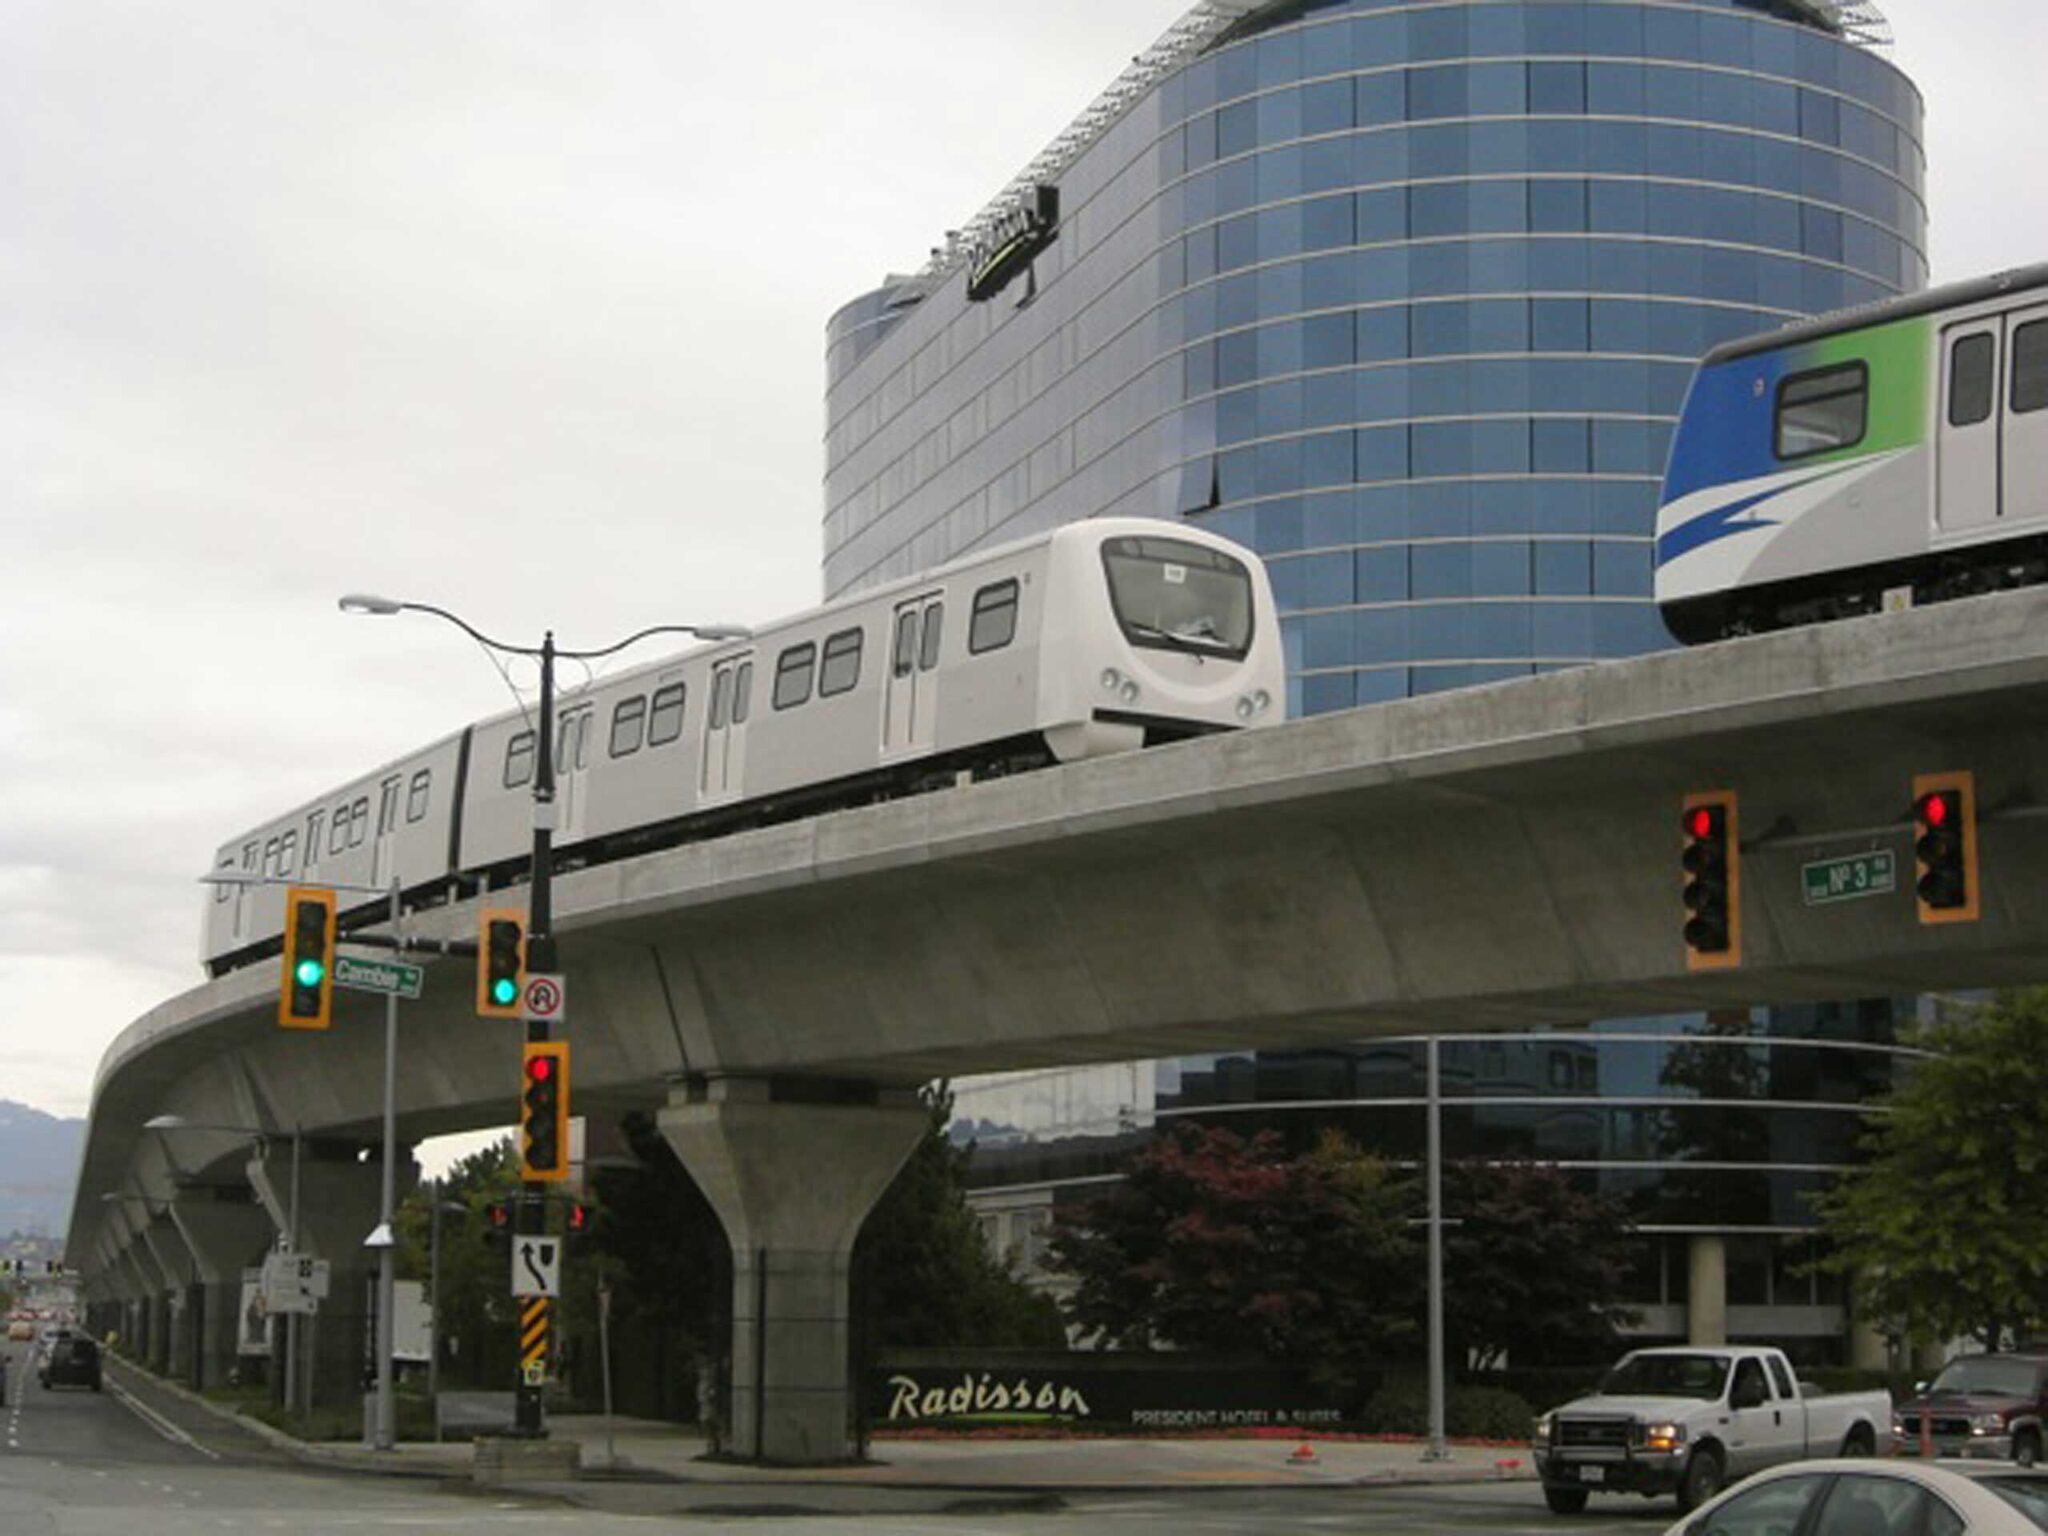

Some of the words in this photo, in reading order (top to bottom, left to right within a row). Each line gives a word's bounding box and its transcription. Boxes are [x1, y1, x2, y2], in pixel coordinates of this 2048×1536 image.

[1855, 861, 1867, 888] 3
[336, 959, 399, 990] Cambie
[889, 1373, 1090, 1420] Radisson
[1131, 1409, 1217, 1425] PRESIDENT
[1220, 1409, 1269, 1424] HOTEL
[1275, 1409, 1289, 1423] &
[1292, 1409, 1343, 1422] SUITES
